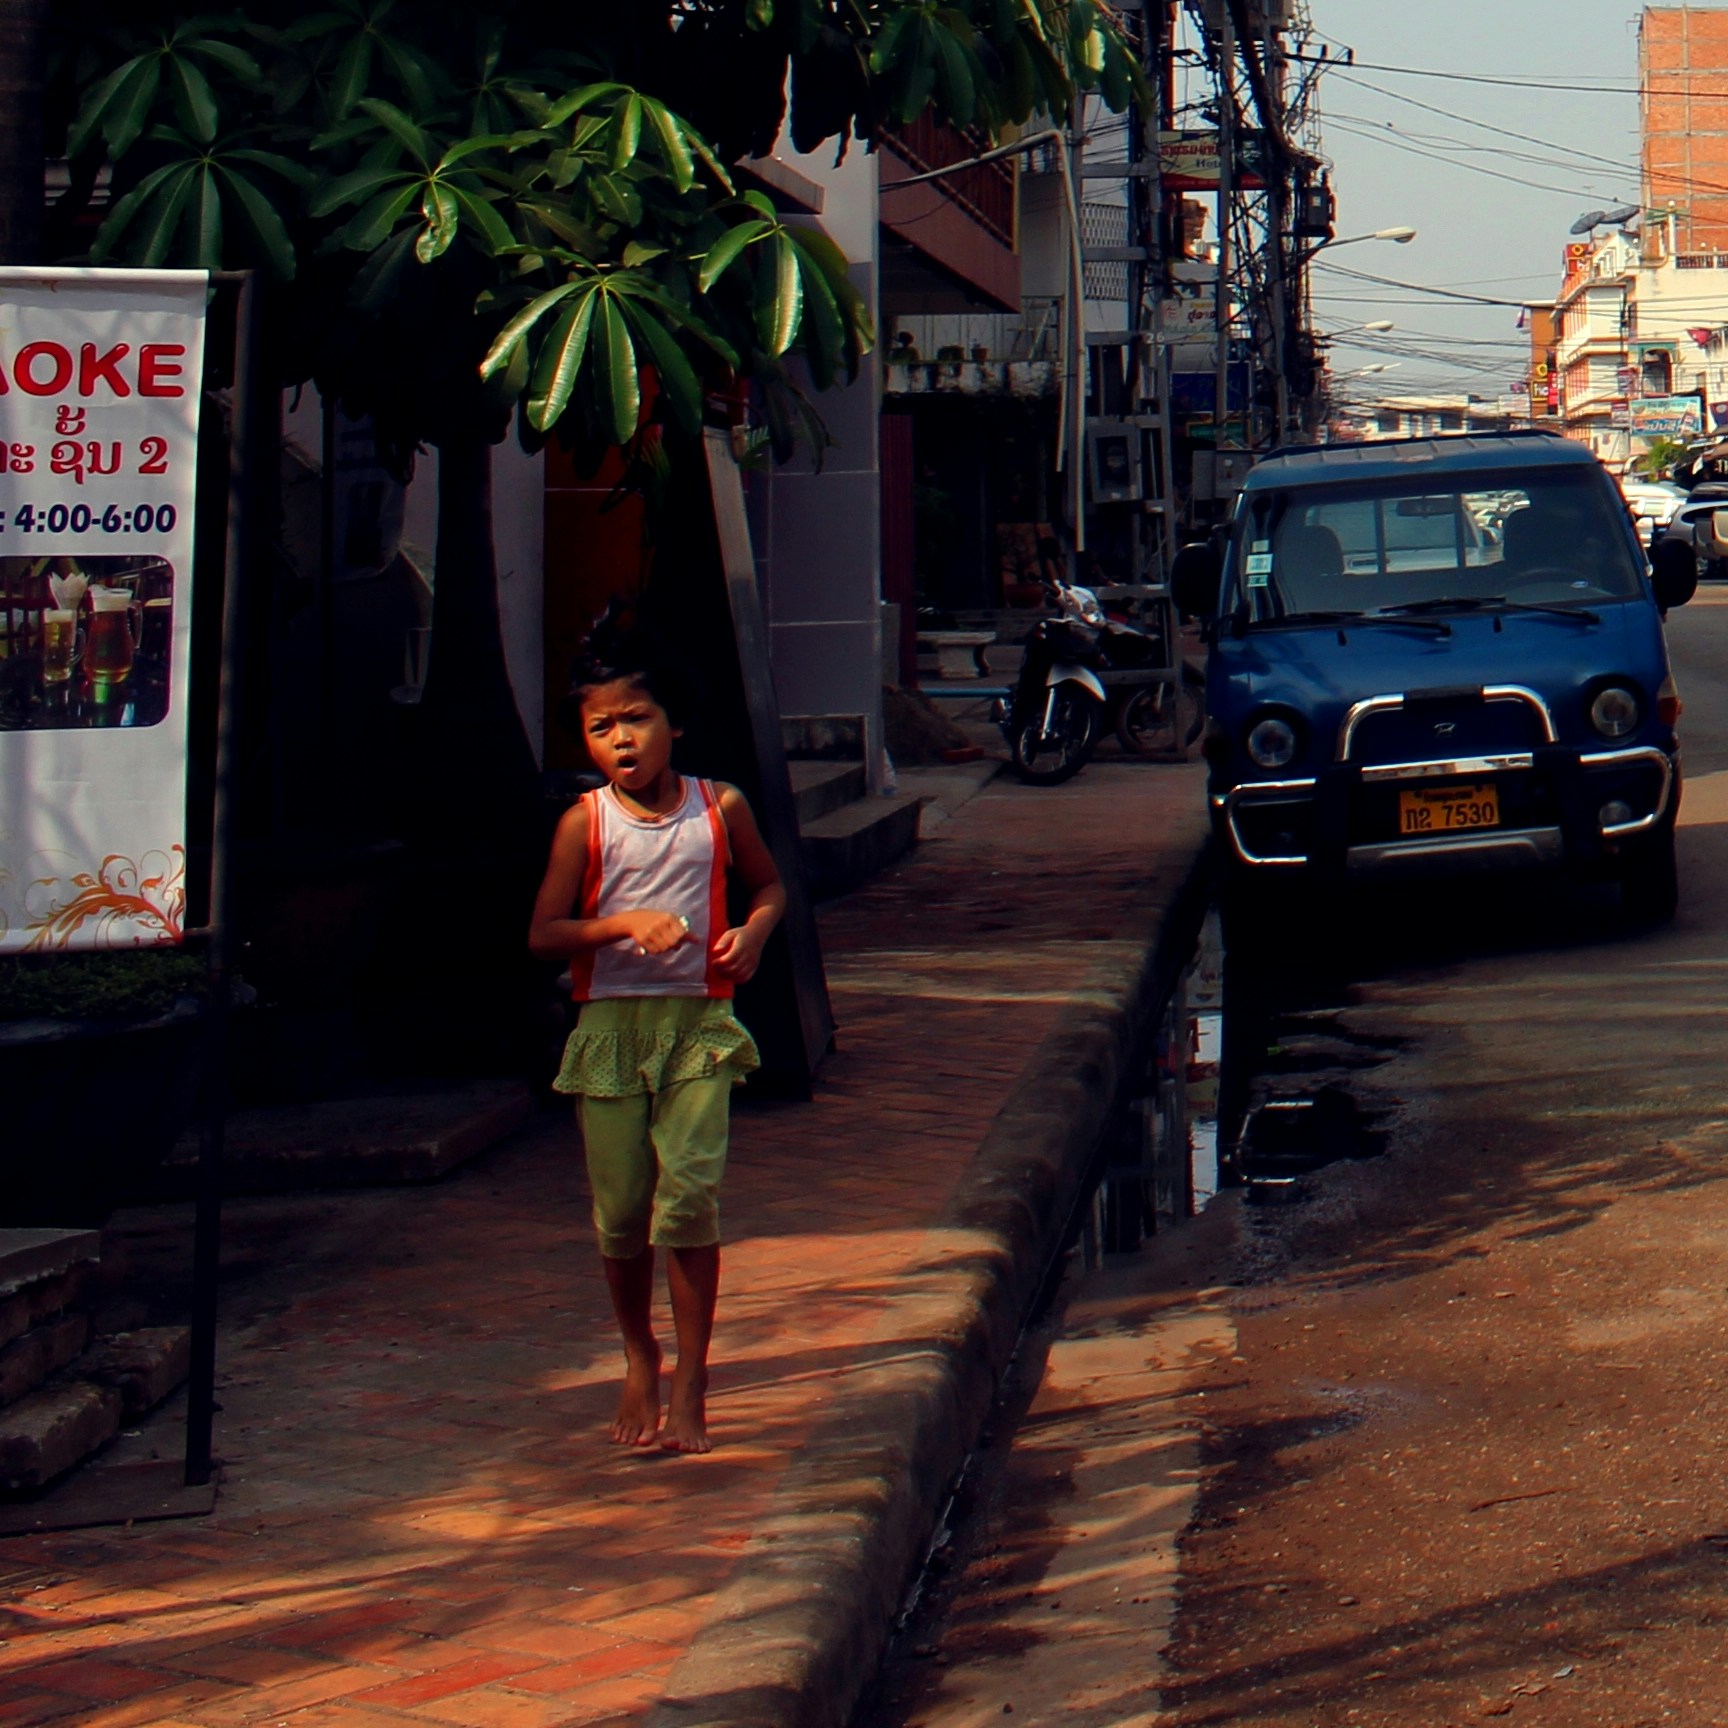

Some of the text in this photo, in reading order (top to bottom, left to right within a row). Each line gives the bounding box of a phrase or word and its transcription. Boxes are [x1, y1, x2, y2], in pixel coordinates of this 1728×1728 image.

[0, 341, 186, 398] OKE
[138, 436, 168, 474] 2
[15, 503, 177, 533] 4:00-6:00
[1442, 801, 1494, 826] 7530
